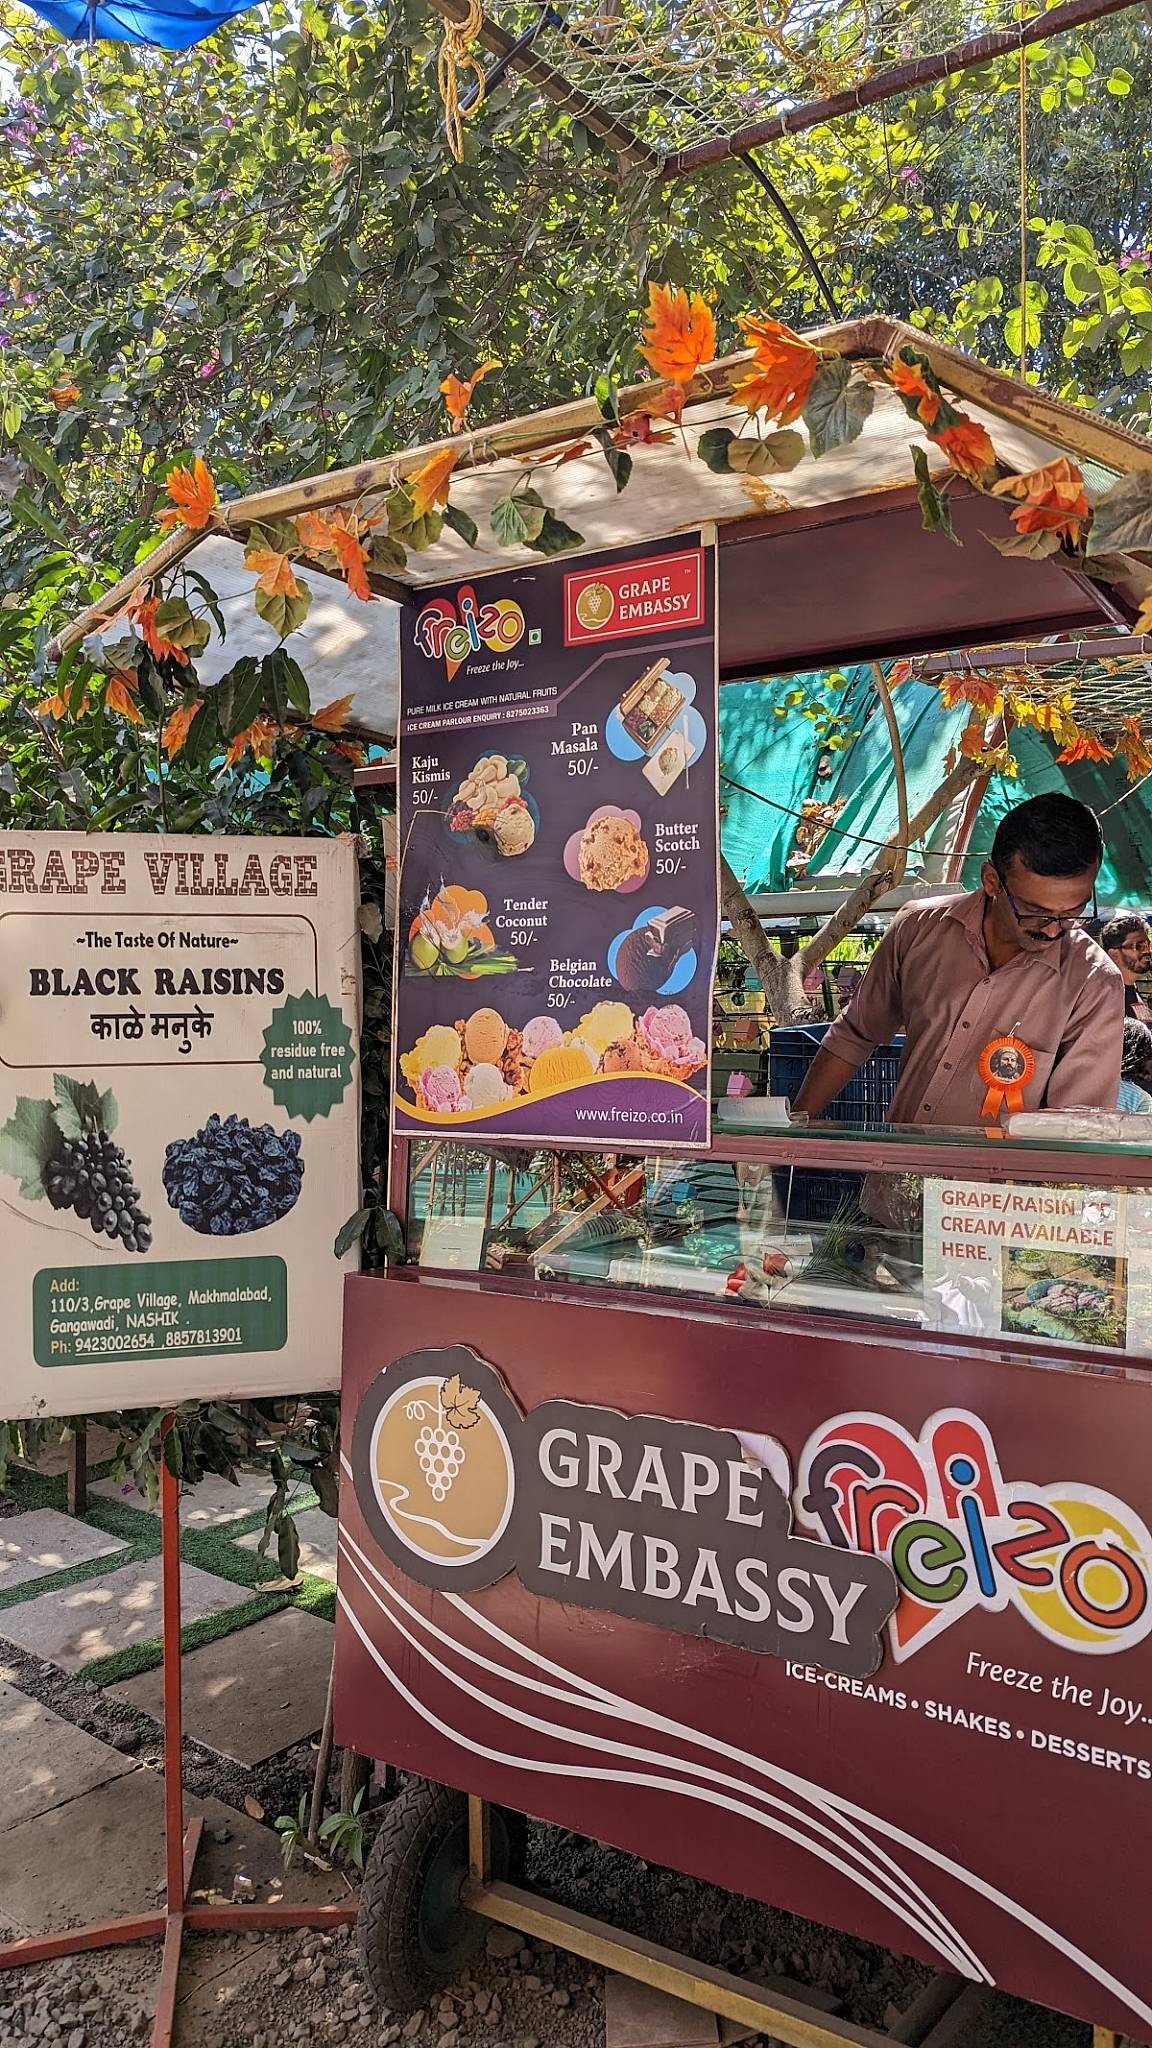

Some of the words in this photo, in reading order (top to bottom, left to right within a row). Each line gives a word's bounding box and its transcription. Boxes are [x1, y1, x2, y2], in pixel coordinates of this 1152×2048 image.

[618, 576, 671, 600] GRAPE
[619, 594, 691, 620] EMBASSY
[414, 597, 525, 661] freizo
[466, 665, 491, 675] Freeze
[492, 660, 505, 671] the
[407, 706, 425, 716] PURE
[425, 703, 442, 714] MILK
[442, 701, 454, 711] ICE
[454, 698, 479, 710] CREAM
[480, 695, 498, 706] WITH
[499, 690, 531, 703] NATURAL
[532, 686, 558, 699] FRUITS
[407, 722, 418, 732] ICE
[418, 719, 442, 731] CREAM
[442, 714, 472, 727] PARLOUR
[473, 711, 501, 723] ENQUIRY
[506, 705, 549, 719] 8275023363
[571, 722, 598, 736] Pan
[551, 739, 598, 756] Masala
[412, 756, 439, 772] Kaju
[567, 757, 599, 777] 50/-
[412, 767, 451, 785] Kismis
[412, 788, 439, 806] 50/-
[655, 821, 699, 837] Butter
[655, 837, 701, 853] Scotch
[144, 851, 318, 897] VILLAGE
[655, 858, 687, 876] 50/-
[503, 898, 549, 912] Tender
[496, 914, 548, 928] Coconut
[114, 931, 155, 949] Taste
[157, 931, 177, 949] Of
[510, 930, 539, 946] 50/-
[550, 958, 597, 974] Belgian
[29, 968, 142, 997] BLACK
[155, 968, 285, 996] RAISINS
[549, 975, 612, 989] Chocolate
[547, 993, 576, 1009] 50/-
[90, 1004, 146, 1041] काळे
[150, 1004, 215, 1054] मनुके
[292, 1020, 322, 1036] 100%
[271, 1044, 317, 1058] residue
[320, 1044, 346, 1058] free
[271, 1066, 294, 1080] and
[297, 1064, 342, 1080] natural
[575, 1106, 684, 1125] www.freizo.co.in
[941, 1189, 1076, 1216] GRAPE/RAISIN
[941, 1216, 1006, 1237] CREAM
[942, 1241, 993, 1262] HERE.
[50, 1278, 80, 1293] Add:
[50, 1296, 131, 1315] 110/3,Grape
[137, 1292, 182, 1311] Village,
[188, 1286, 272, 1305] Makhmalabad,
[50, 1316, 119, 1336] Gangawadi,
[126, 1311, 180, 1329] NASHIK
[51, 1339, 72, 1355] Ph:
[75, 1332, 155, 1354] 9423002654
[538, 1427, 764, 1529] GRAPE
[802, 1443, 1148, 1630] freizo
[538, 1511, 868, 1646] EMBASSY
[967, 1651, 1043, 1694] Freeze
[1051, 1675, 1094, 1707] the
[786, 1660, 907, 1710] ICE-CREAMS
[925, 1700, 1012, 1740] SHAKES
[1031, 1729, 1152, 1780] DESSERTS
